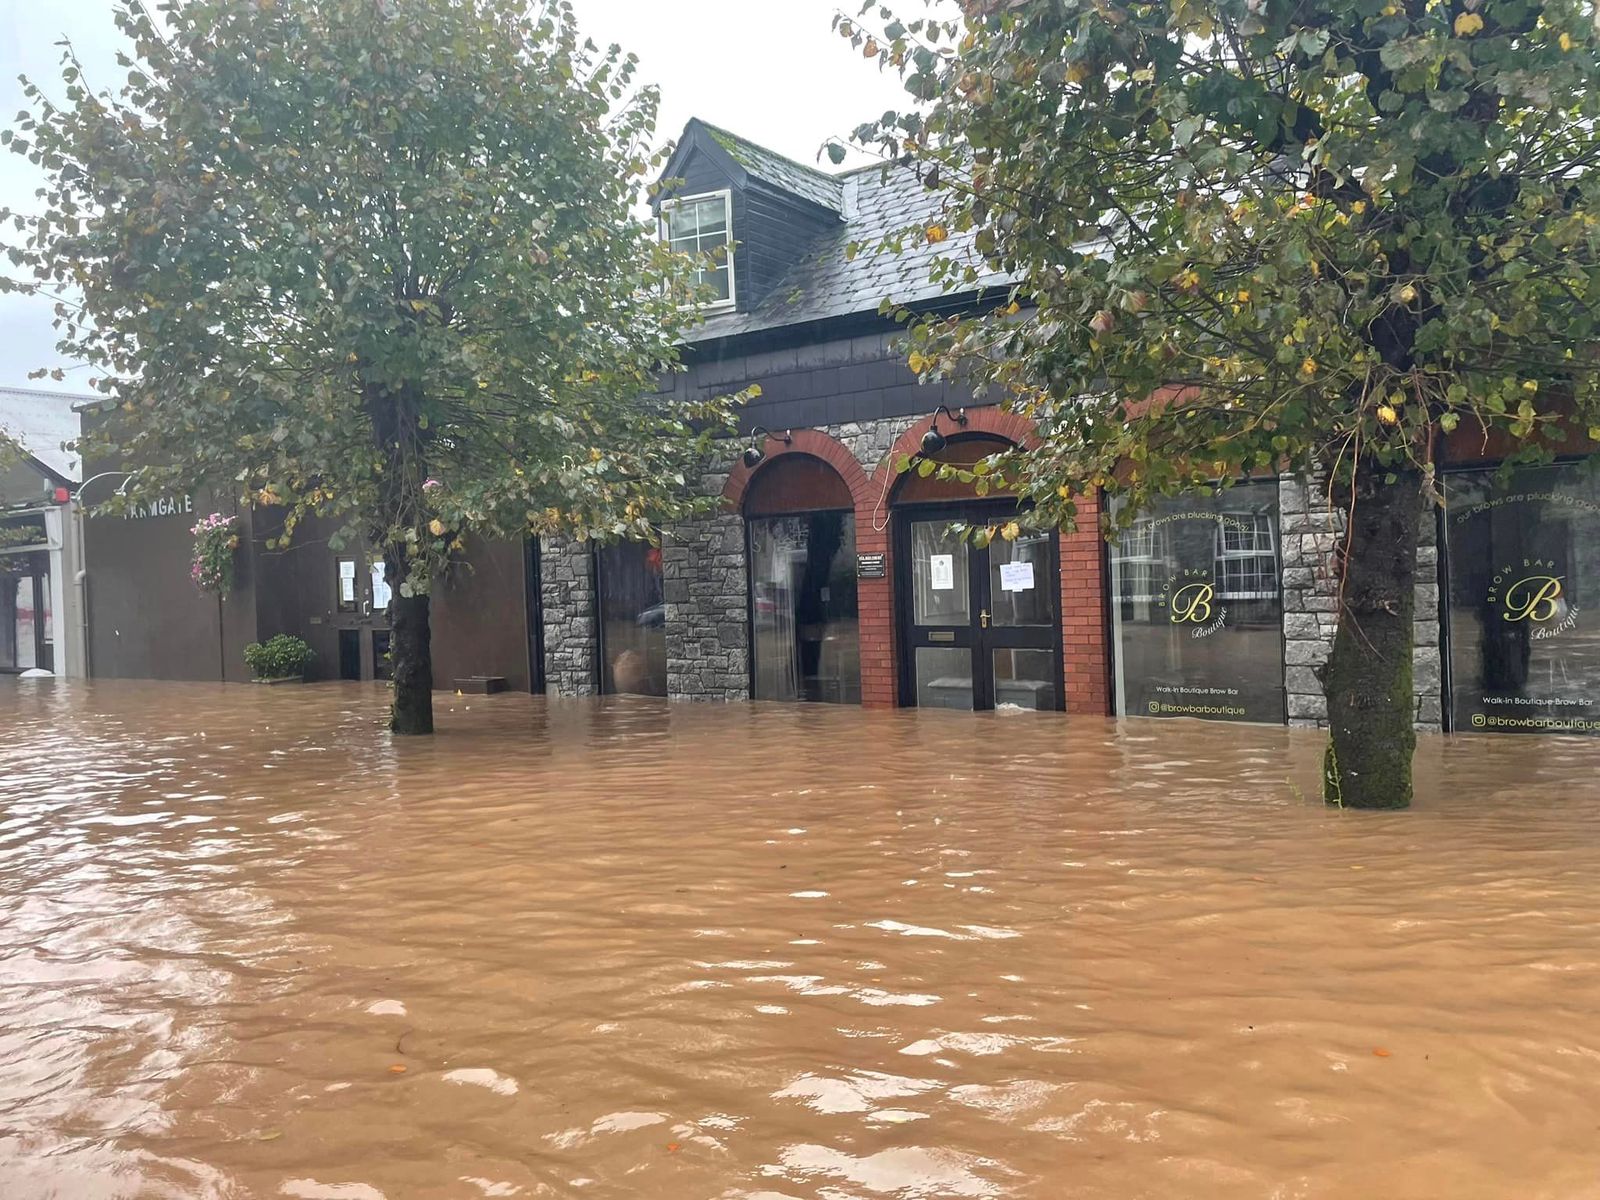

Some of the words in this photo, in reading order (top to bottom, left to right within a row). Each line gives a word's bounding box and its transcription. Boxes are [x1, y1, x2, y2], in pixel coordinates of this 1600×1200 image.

[123, 494, 193, 520] ARMGAE
[1473, 497, 1503, 514] brows
[1505, 494, 1524, 503] are
[1527, 491, 1574, 505] plucking
[1172, 513, 1186, 521] are
[1187, 511, 1223, 523] plucking
[1158, 574, 1177, 607] BROW
[1184, 568, 1208, 577] BAR
[1487, 565, 1512, 602] BROW
[1523, 559, 1554, 569] BAR
[1171, 582, 1215, 623] B
[1503, 575, 1566, 622] B
[1191, 606, 1228, 639] Boutique
[1530, 604, 1580, 640] Boutique
[1156, 686, 1179, 694] Walk-in
[1180, 687, 1208, 695] Boutique
[1209, 687, 1226, 695] Brow
[1482, 696, 1512, 704] Walk-in
[1514, 697, 1553, 706] Boutique
[1554, 697, 1576, 706] Brow
[1578, 698, 1593, 706] Bar
[1160, 703, 1245, 716] @browbarboutique
[1487, 716, 1600, 730] @browbarboutique
